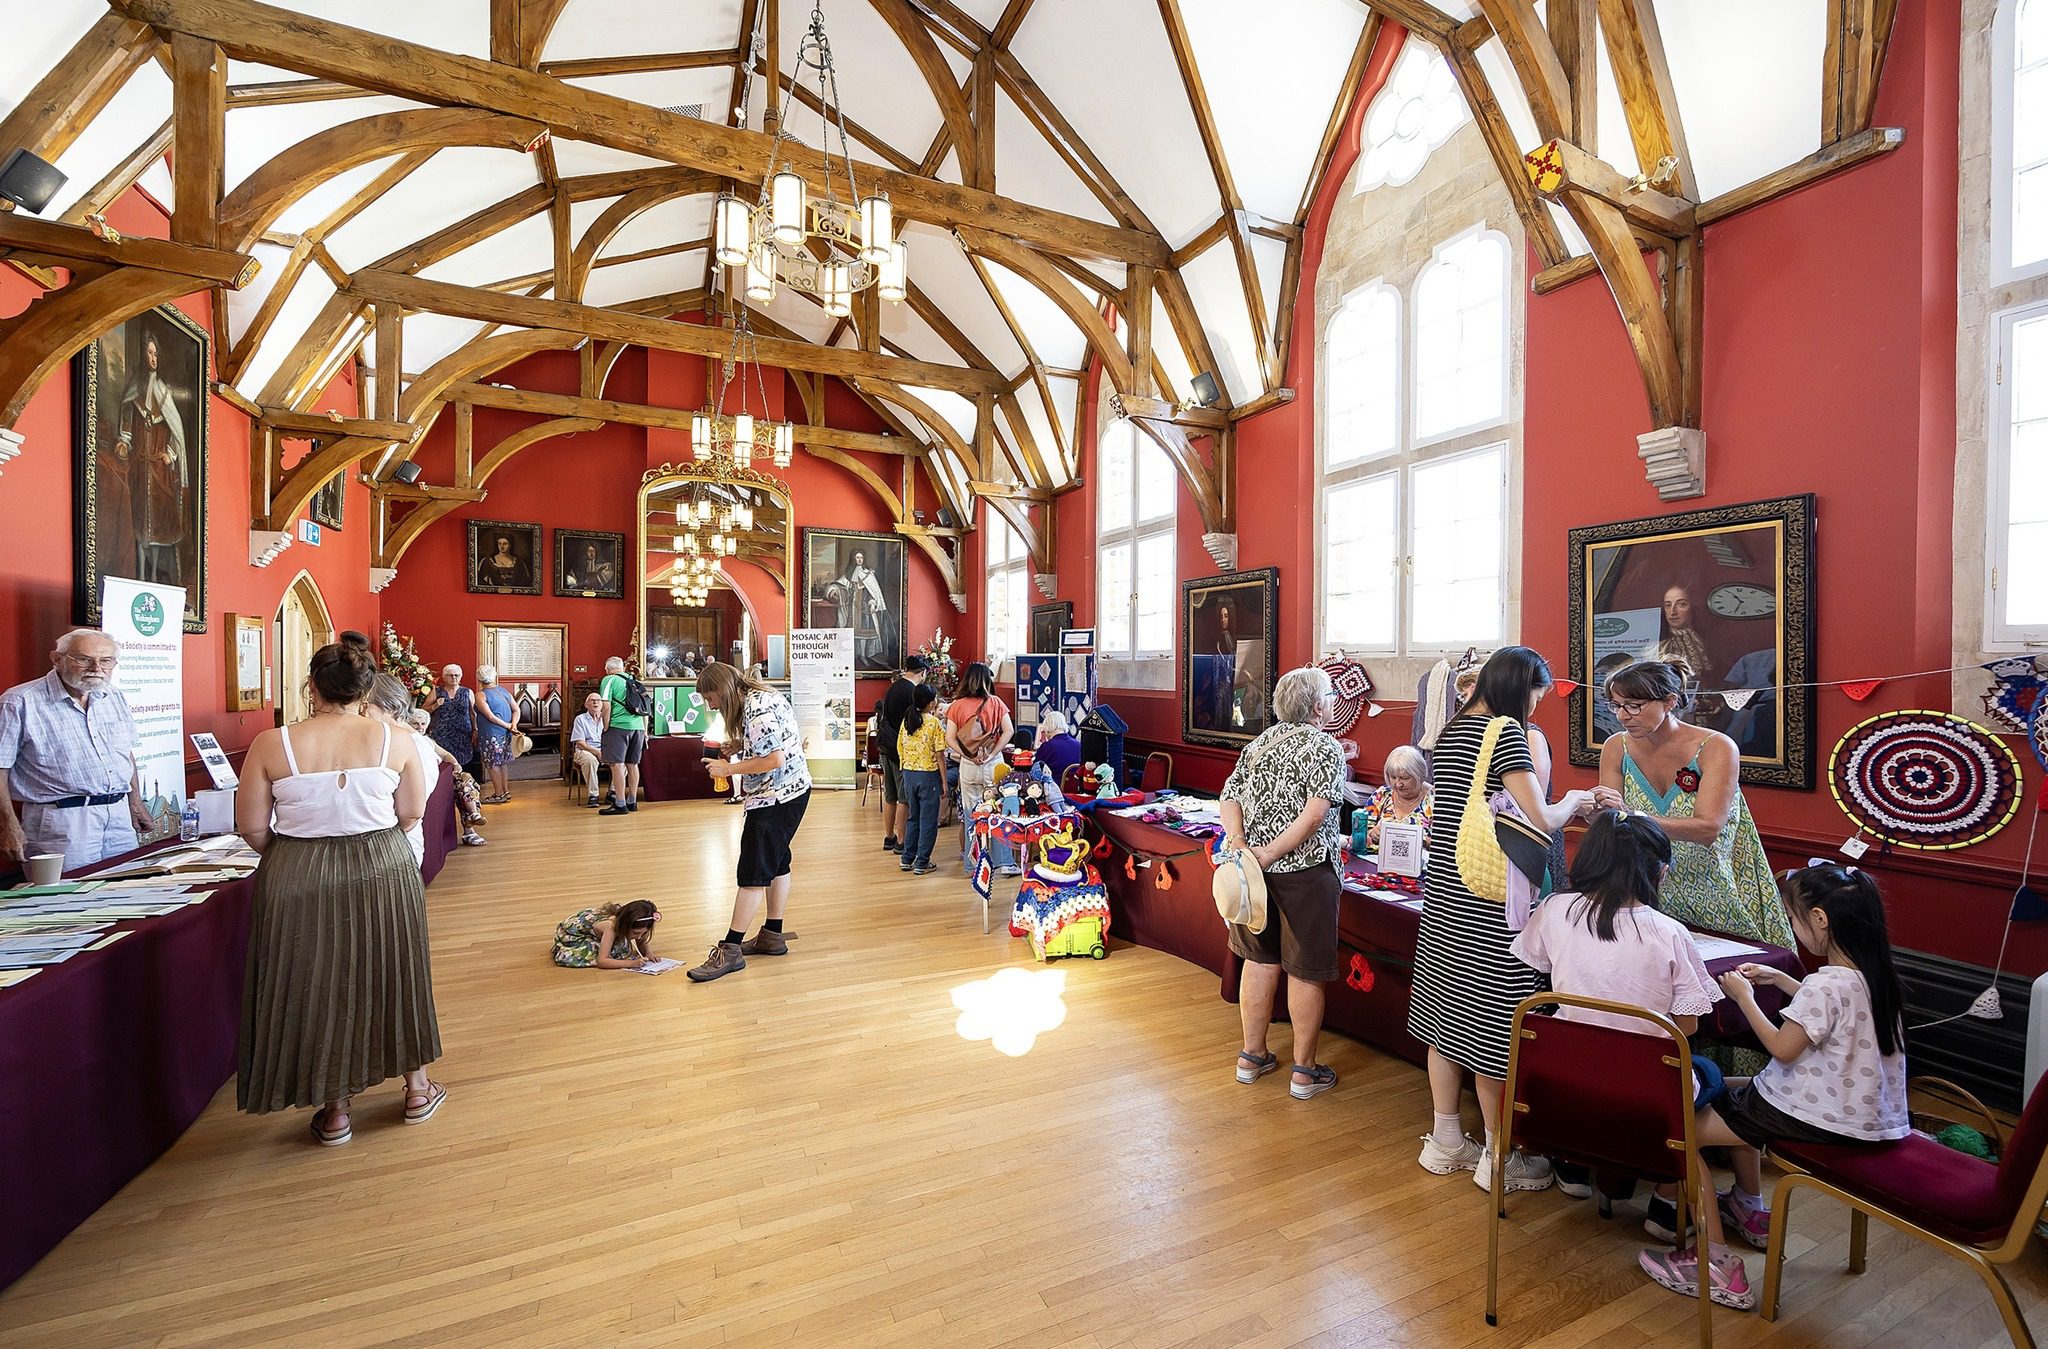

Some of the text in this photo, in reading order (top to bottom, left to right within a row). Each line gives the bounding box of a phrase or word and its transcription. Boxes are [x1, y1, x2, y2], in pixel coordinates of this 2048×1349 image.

[126, 641, 142, 652] Society
[791, 642, 829, 650] THROUGH
[145, 704, 160, 712] awards
[161, 703, 175, 712] grants
